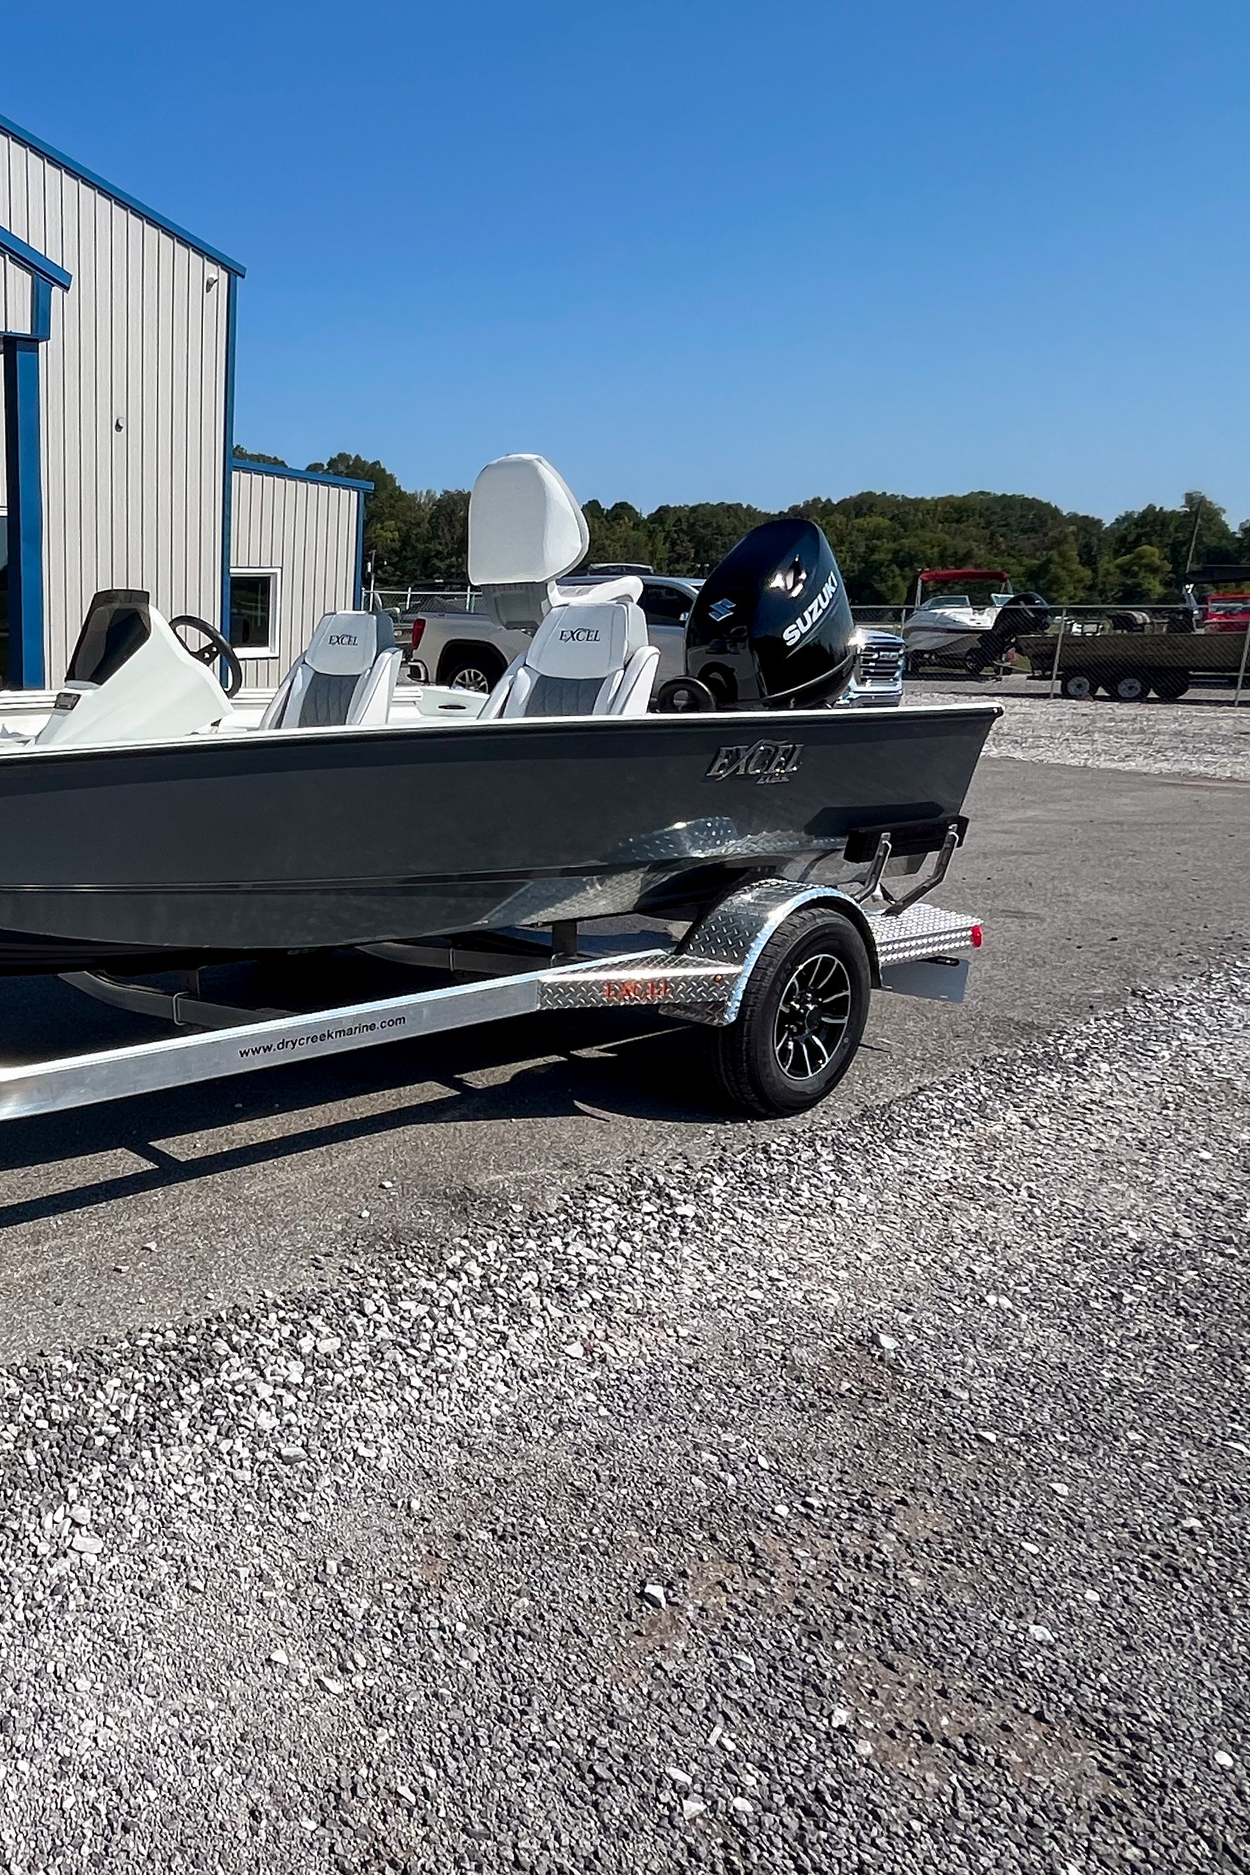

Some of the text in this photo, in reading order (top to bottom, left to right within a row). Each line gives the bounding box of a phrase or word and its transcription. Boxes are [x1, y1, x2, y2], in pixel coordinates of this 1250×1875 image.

[782, 570, 838, 646] SUZUKI
[328, 633, 358, 646] EXCEL
[559, 627, 600, 643] EXCEL
[706, 738, 804, 781] EXCEL
[604, 979, 671, 1000] EXEL
[239, 1016, 406, 1058] www.drycreekmarine.com
